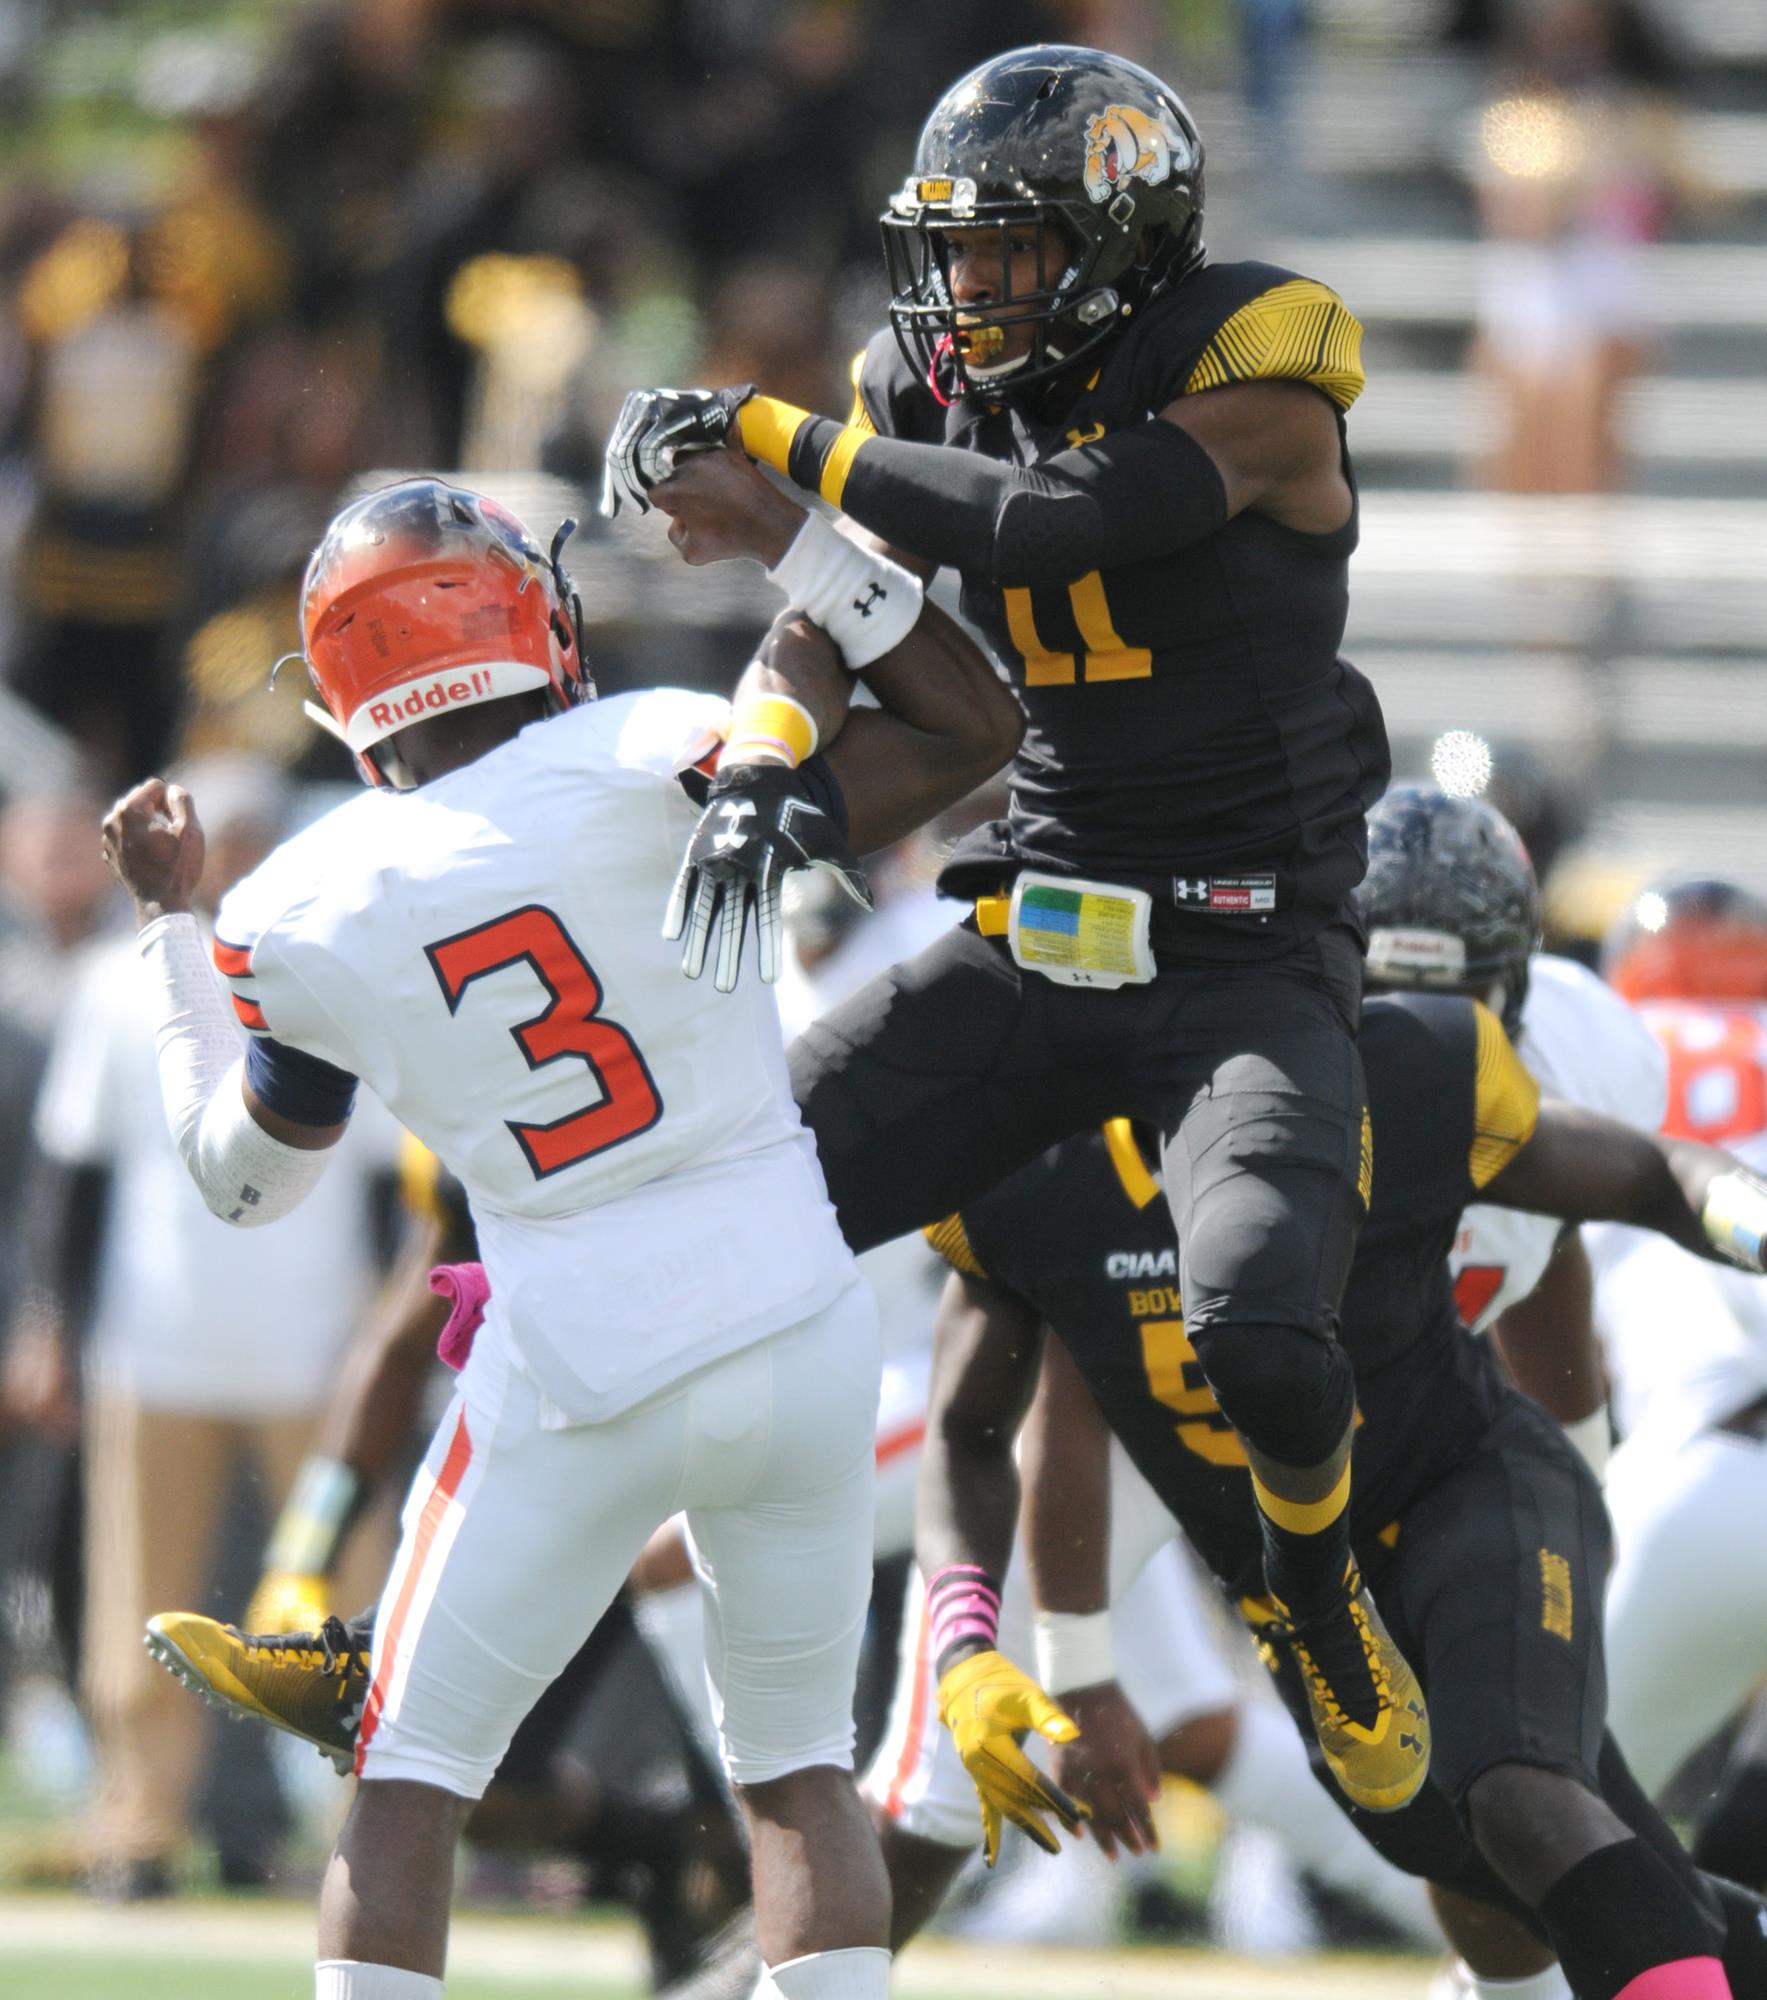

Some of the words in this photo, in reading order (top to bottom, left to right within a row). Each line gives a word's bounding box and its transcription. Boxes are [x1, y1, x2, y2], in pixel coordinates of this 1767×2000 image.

[1003, 569, 1152, 687] 11
[368, 669, 494, 729] Riddell
[422, 903, 664, 1182] 3
[1106, 1250, 1178, 1278] CIAA
